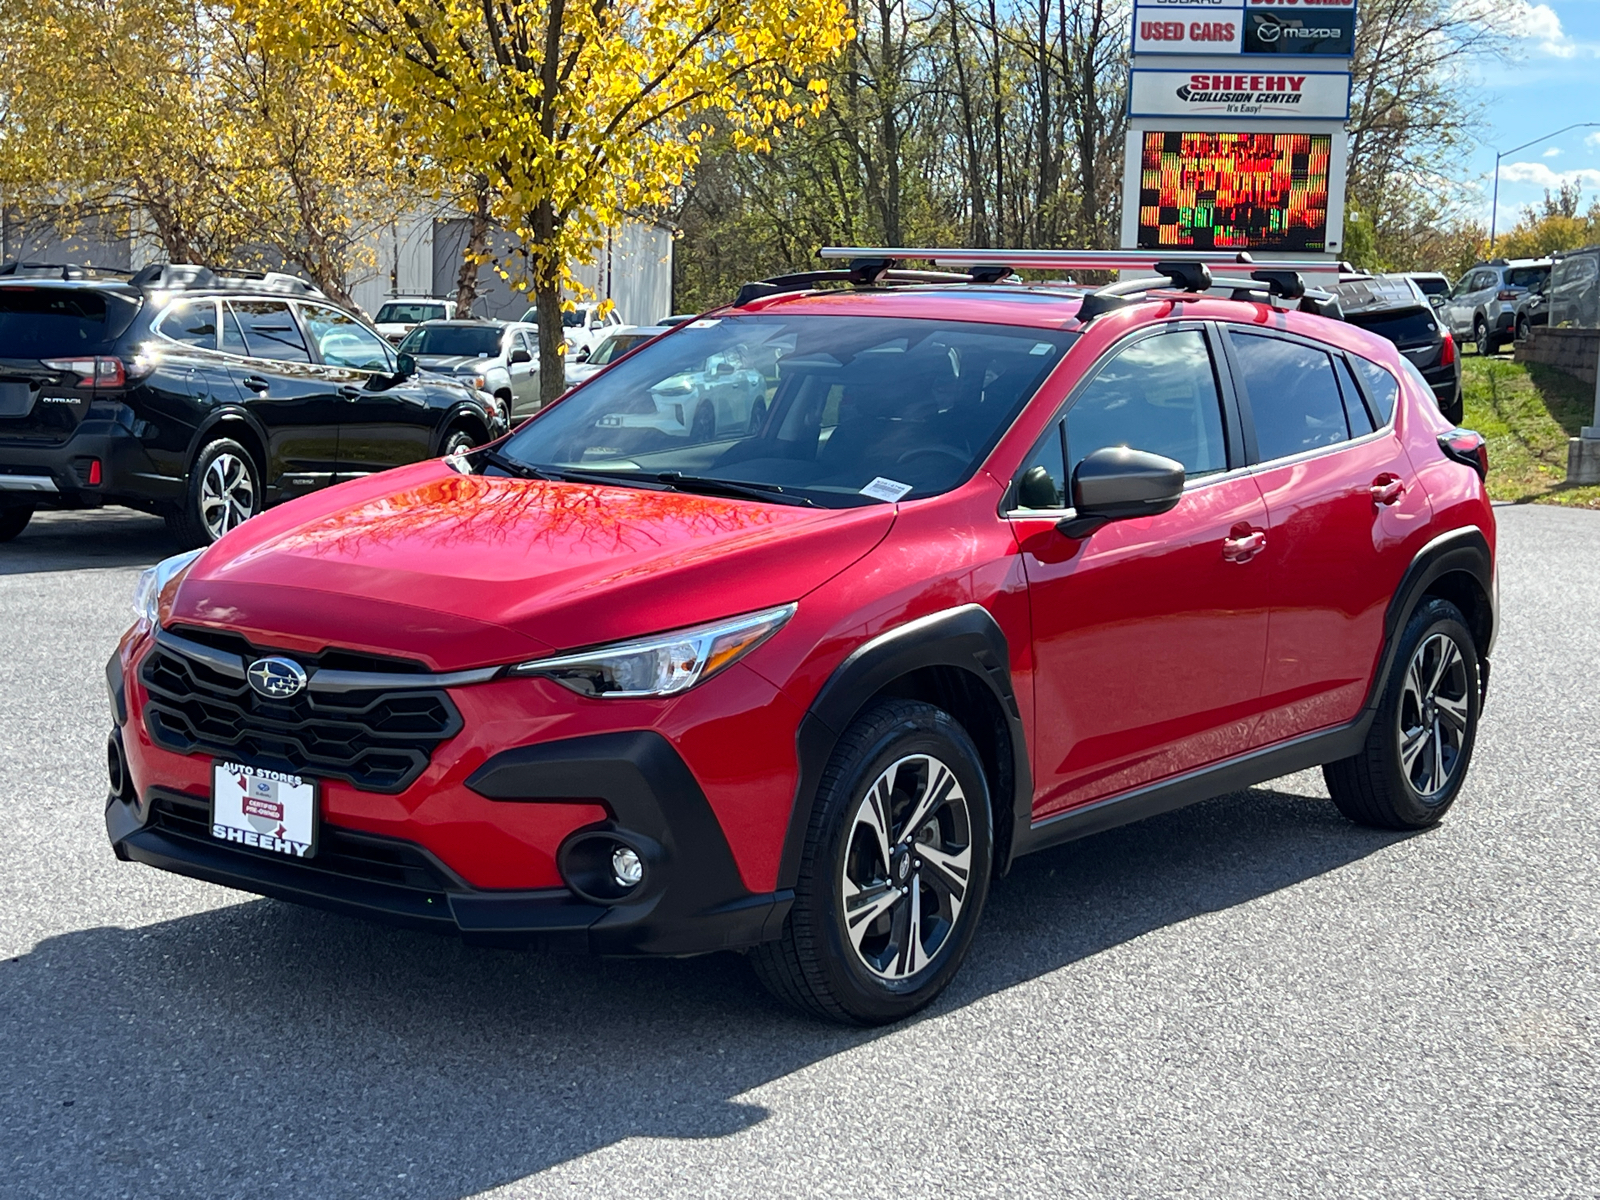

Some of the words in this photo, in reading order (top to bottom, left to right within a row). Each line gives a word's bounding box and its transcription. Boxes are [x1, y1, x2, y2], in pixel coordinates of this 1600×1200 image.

[1141, 21, 1185, 41] USED
[1189, 22, 1235, 42] CARS
[1283, 28, 1341, 39] mazda
[1190, 75, 1306, 91] SHEEHY
[1189, 92, 1254, 103] COLLISION
[1255, 93, 1303, 104] CENTER
[1226, 104, 1238, 113] It's
[1240, 105, 1262, 114] Easy!
[223, 762, 253, 775] AUTO
[257, 768, 302, 785] STORES
[246, 805, 280, 818] PRE-OWNED
[249, 799, 277, 811] CERTIFIED
[213, 825, 309, 857] SHEEHY
